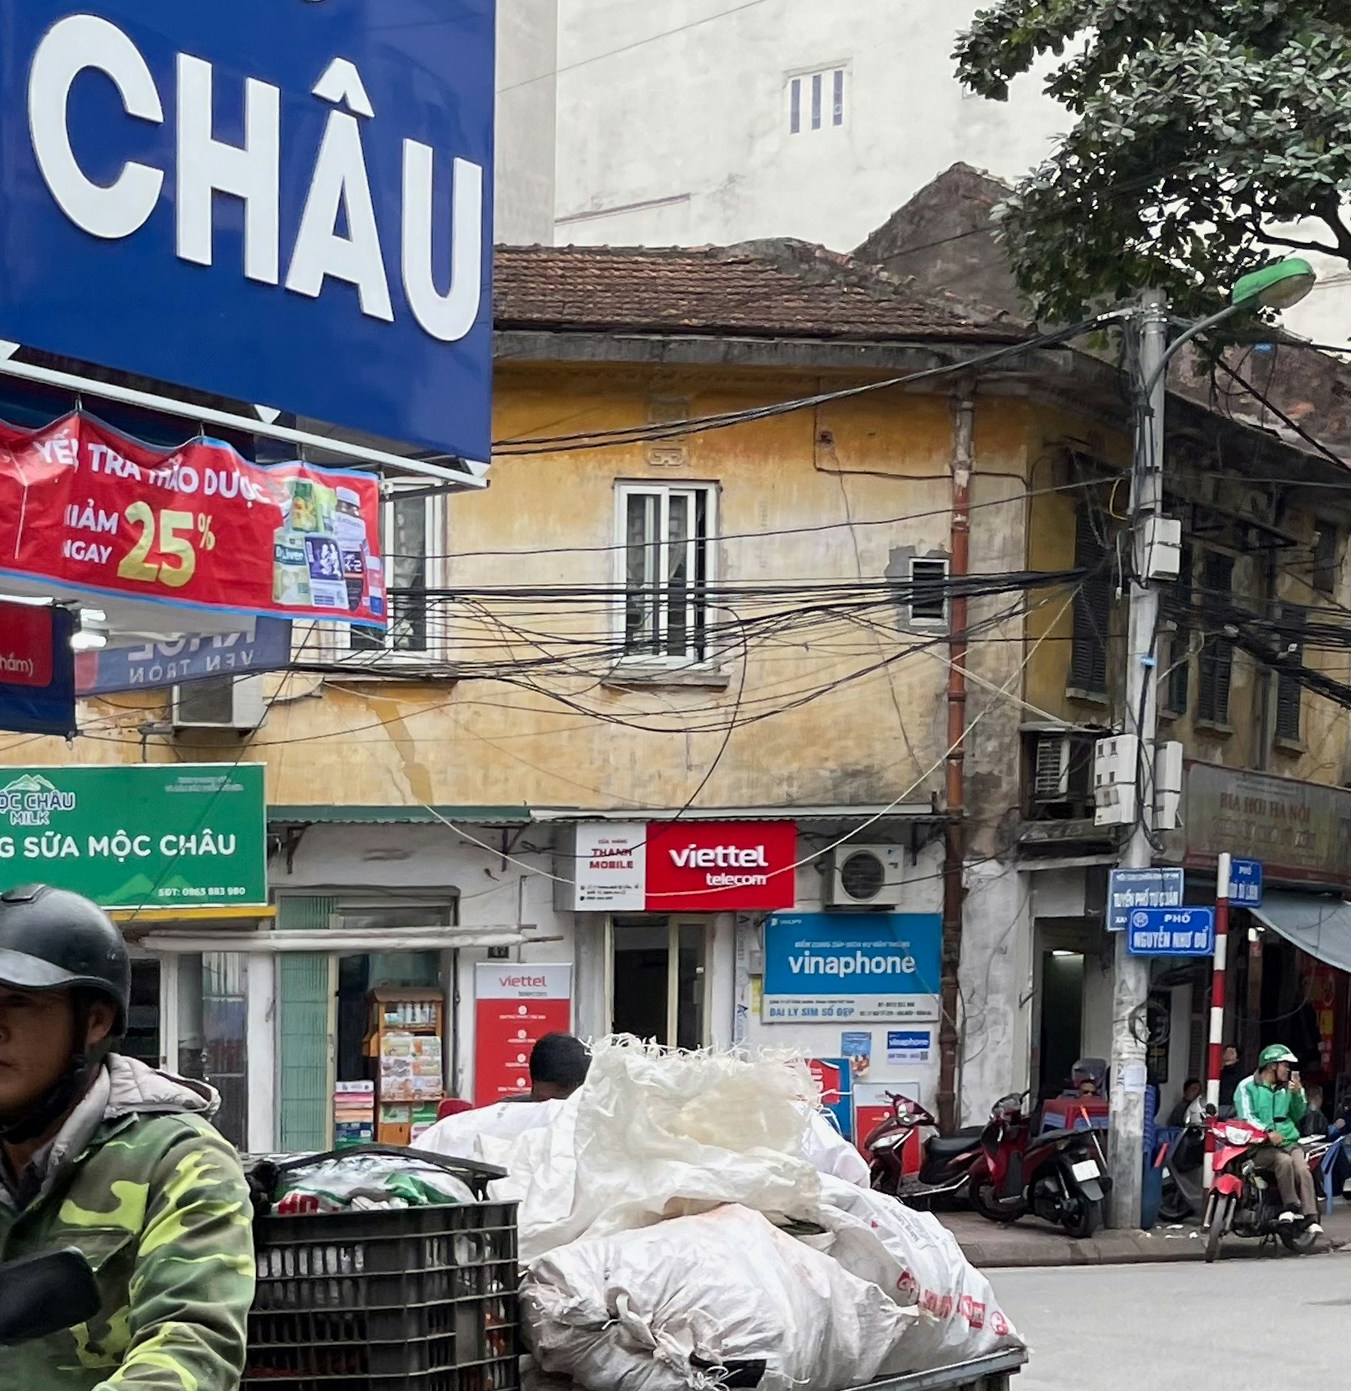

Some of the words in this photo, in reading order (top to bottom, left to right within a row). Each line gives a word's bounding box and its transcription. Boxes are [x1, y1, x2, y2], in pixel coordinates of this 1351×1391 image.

[28, 14, 483, 342] CHÂU
[116, 501, 216, 588] 25%
[24, 789, 76, 812] CHÂU
[9, 810, 50, 826] MILK
[23, 831, 80, 859] SỮA
[88, 829, 152, 863] MỘC
[159, 828, 237, 857] CHÂU
[668, 843, 769, 868] viettel
[589, 861, 634, 870] MOBILE
[705, 872, 767, 886] telecom
[1163, 911, 1192, 923] PHỐ
[788, 950, 916, 978] vinaphone
[499, 975, 547, 987] viettel
